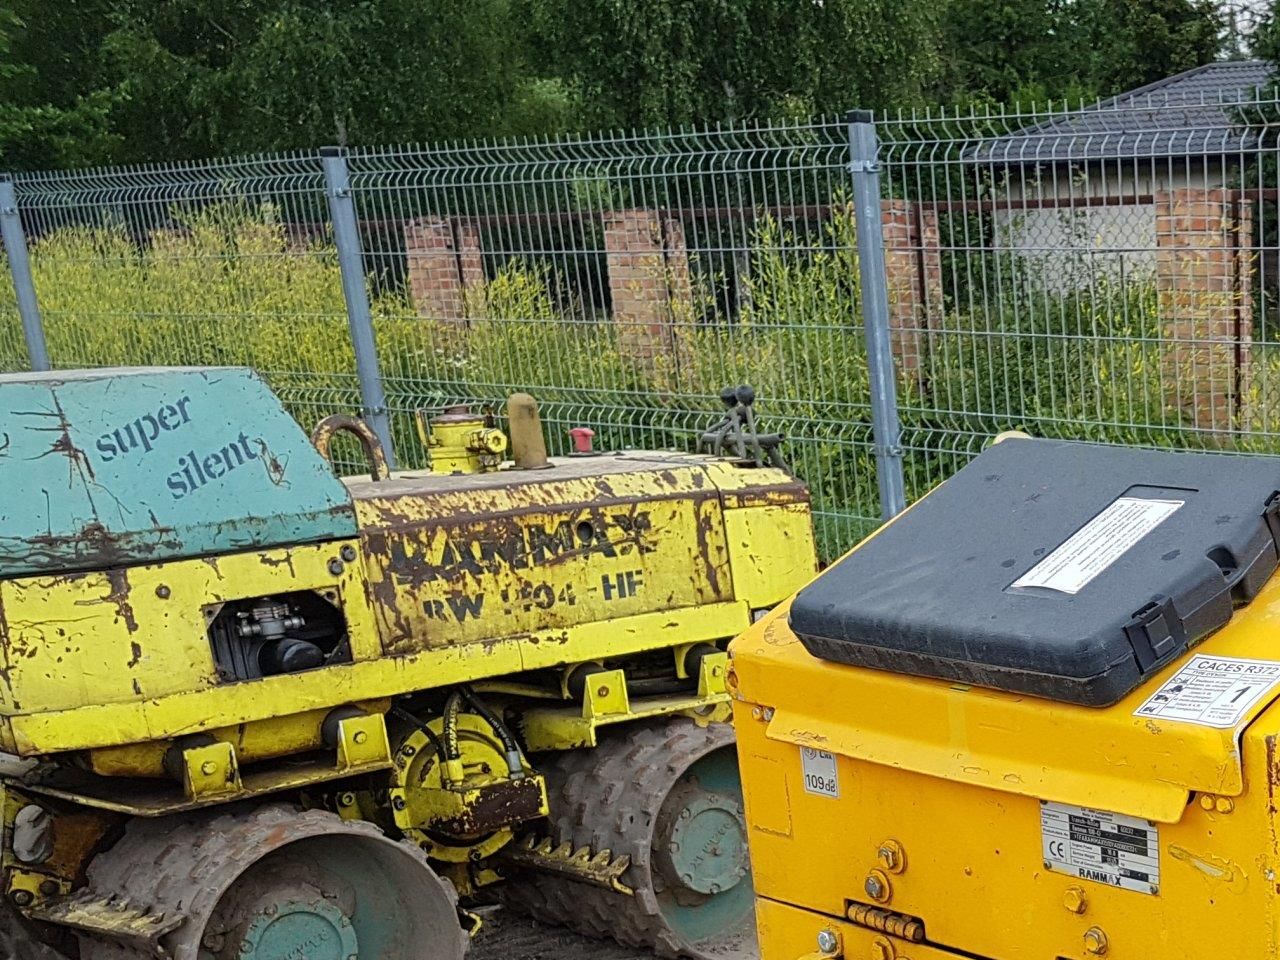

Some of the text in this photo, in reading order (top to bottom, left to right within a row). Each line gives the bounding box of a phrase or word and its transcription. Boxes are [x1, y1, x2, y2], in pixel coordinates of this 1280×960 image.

[96, 395, 192, 462] super
[166, 431, 258, 500] silent
[422, 592, 485, 623] RW
[1197, 660, 1279, 675] CACES R372
[1231, 686, 1251, 703] 1
[1079, 868, 1121, 886] RAMMAX
